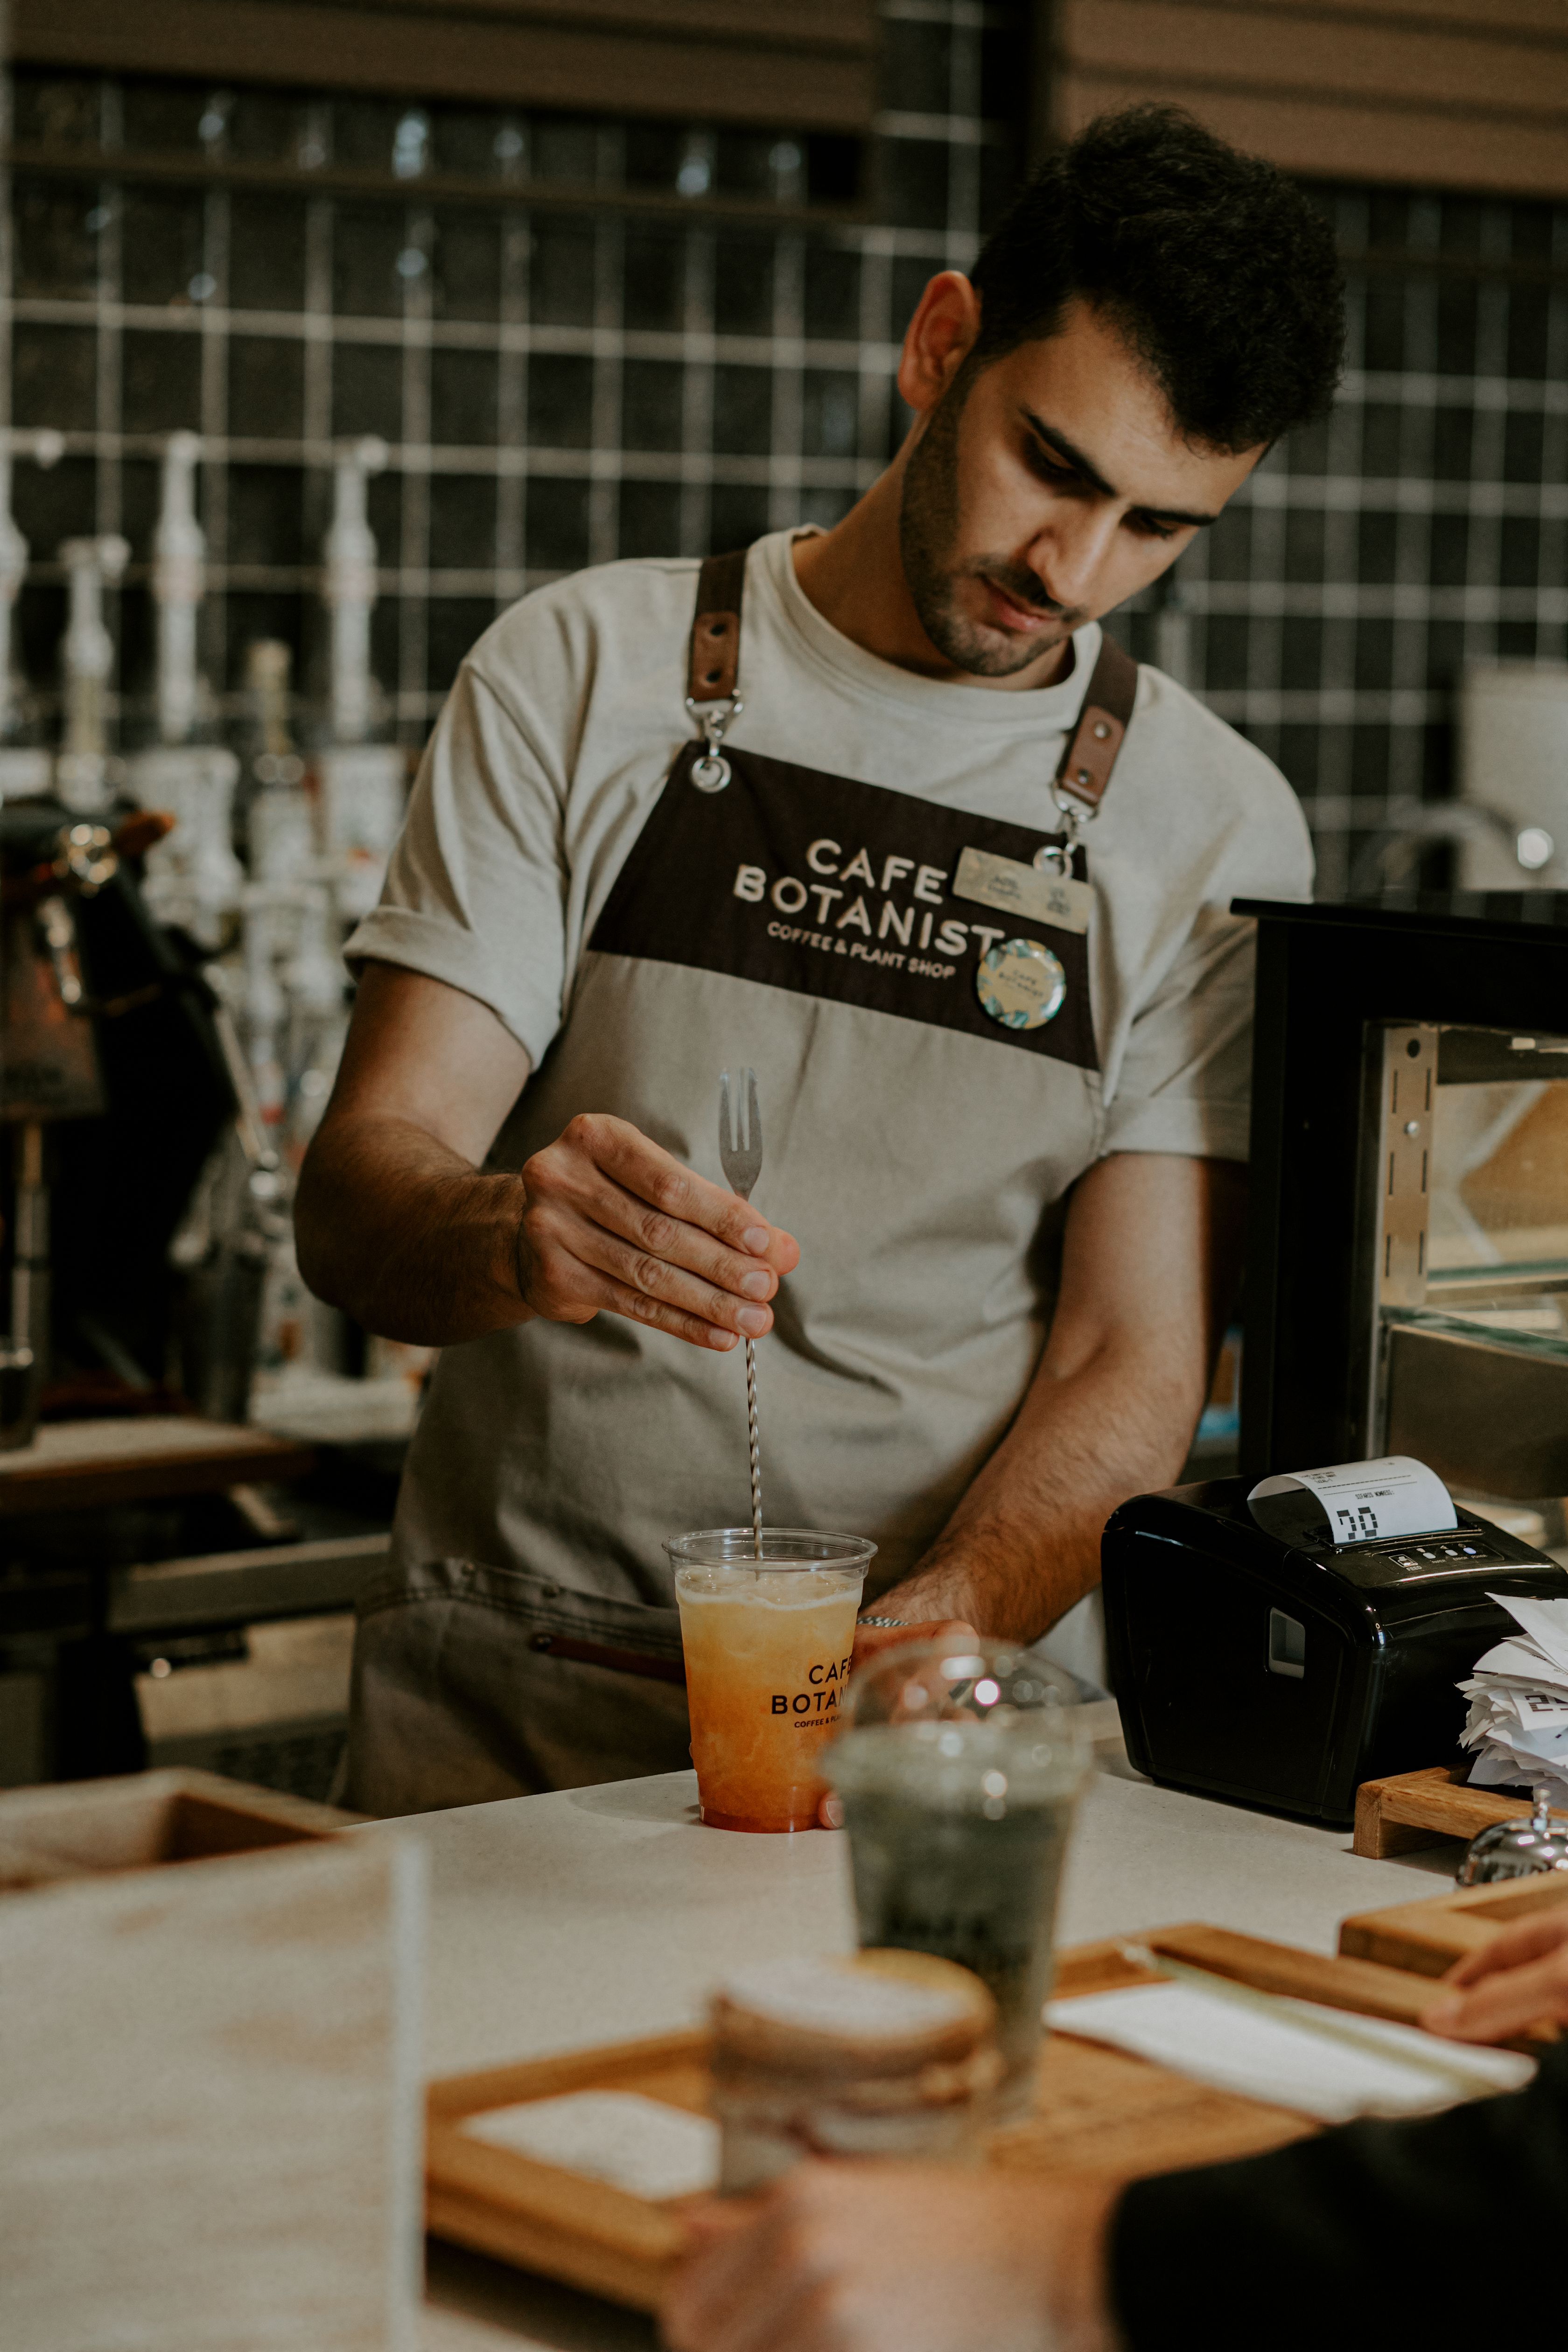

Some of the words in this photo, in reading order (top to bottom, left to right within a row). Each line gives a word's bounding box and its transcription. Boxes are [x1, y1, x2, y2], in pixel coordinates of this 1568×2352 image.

[806, 839, 947, 904] CAFE
[733, 864, 1006, 962] BOTANIST
[767, 921, 833, 951] COFFEE
[834, 938, 847, 954] &
[850, 943, 906, 969] PLANT
[908, 958, 956, 979] SHOP
[794, 1718, 824, 1728] COFFEE
